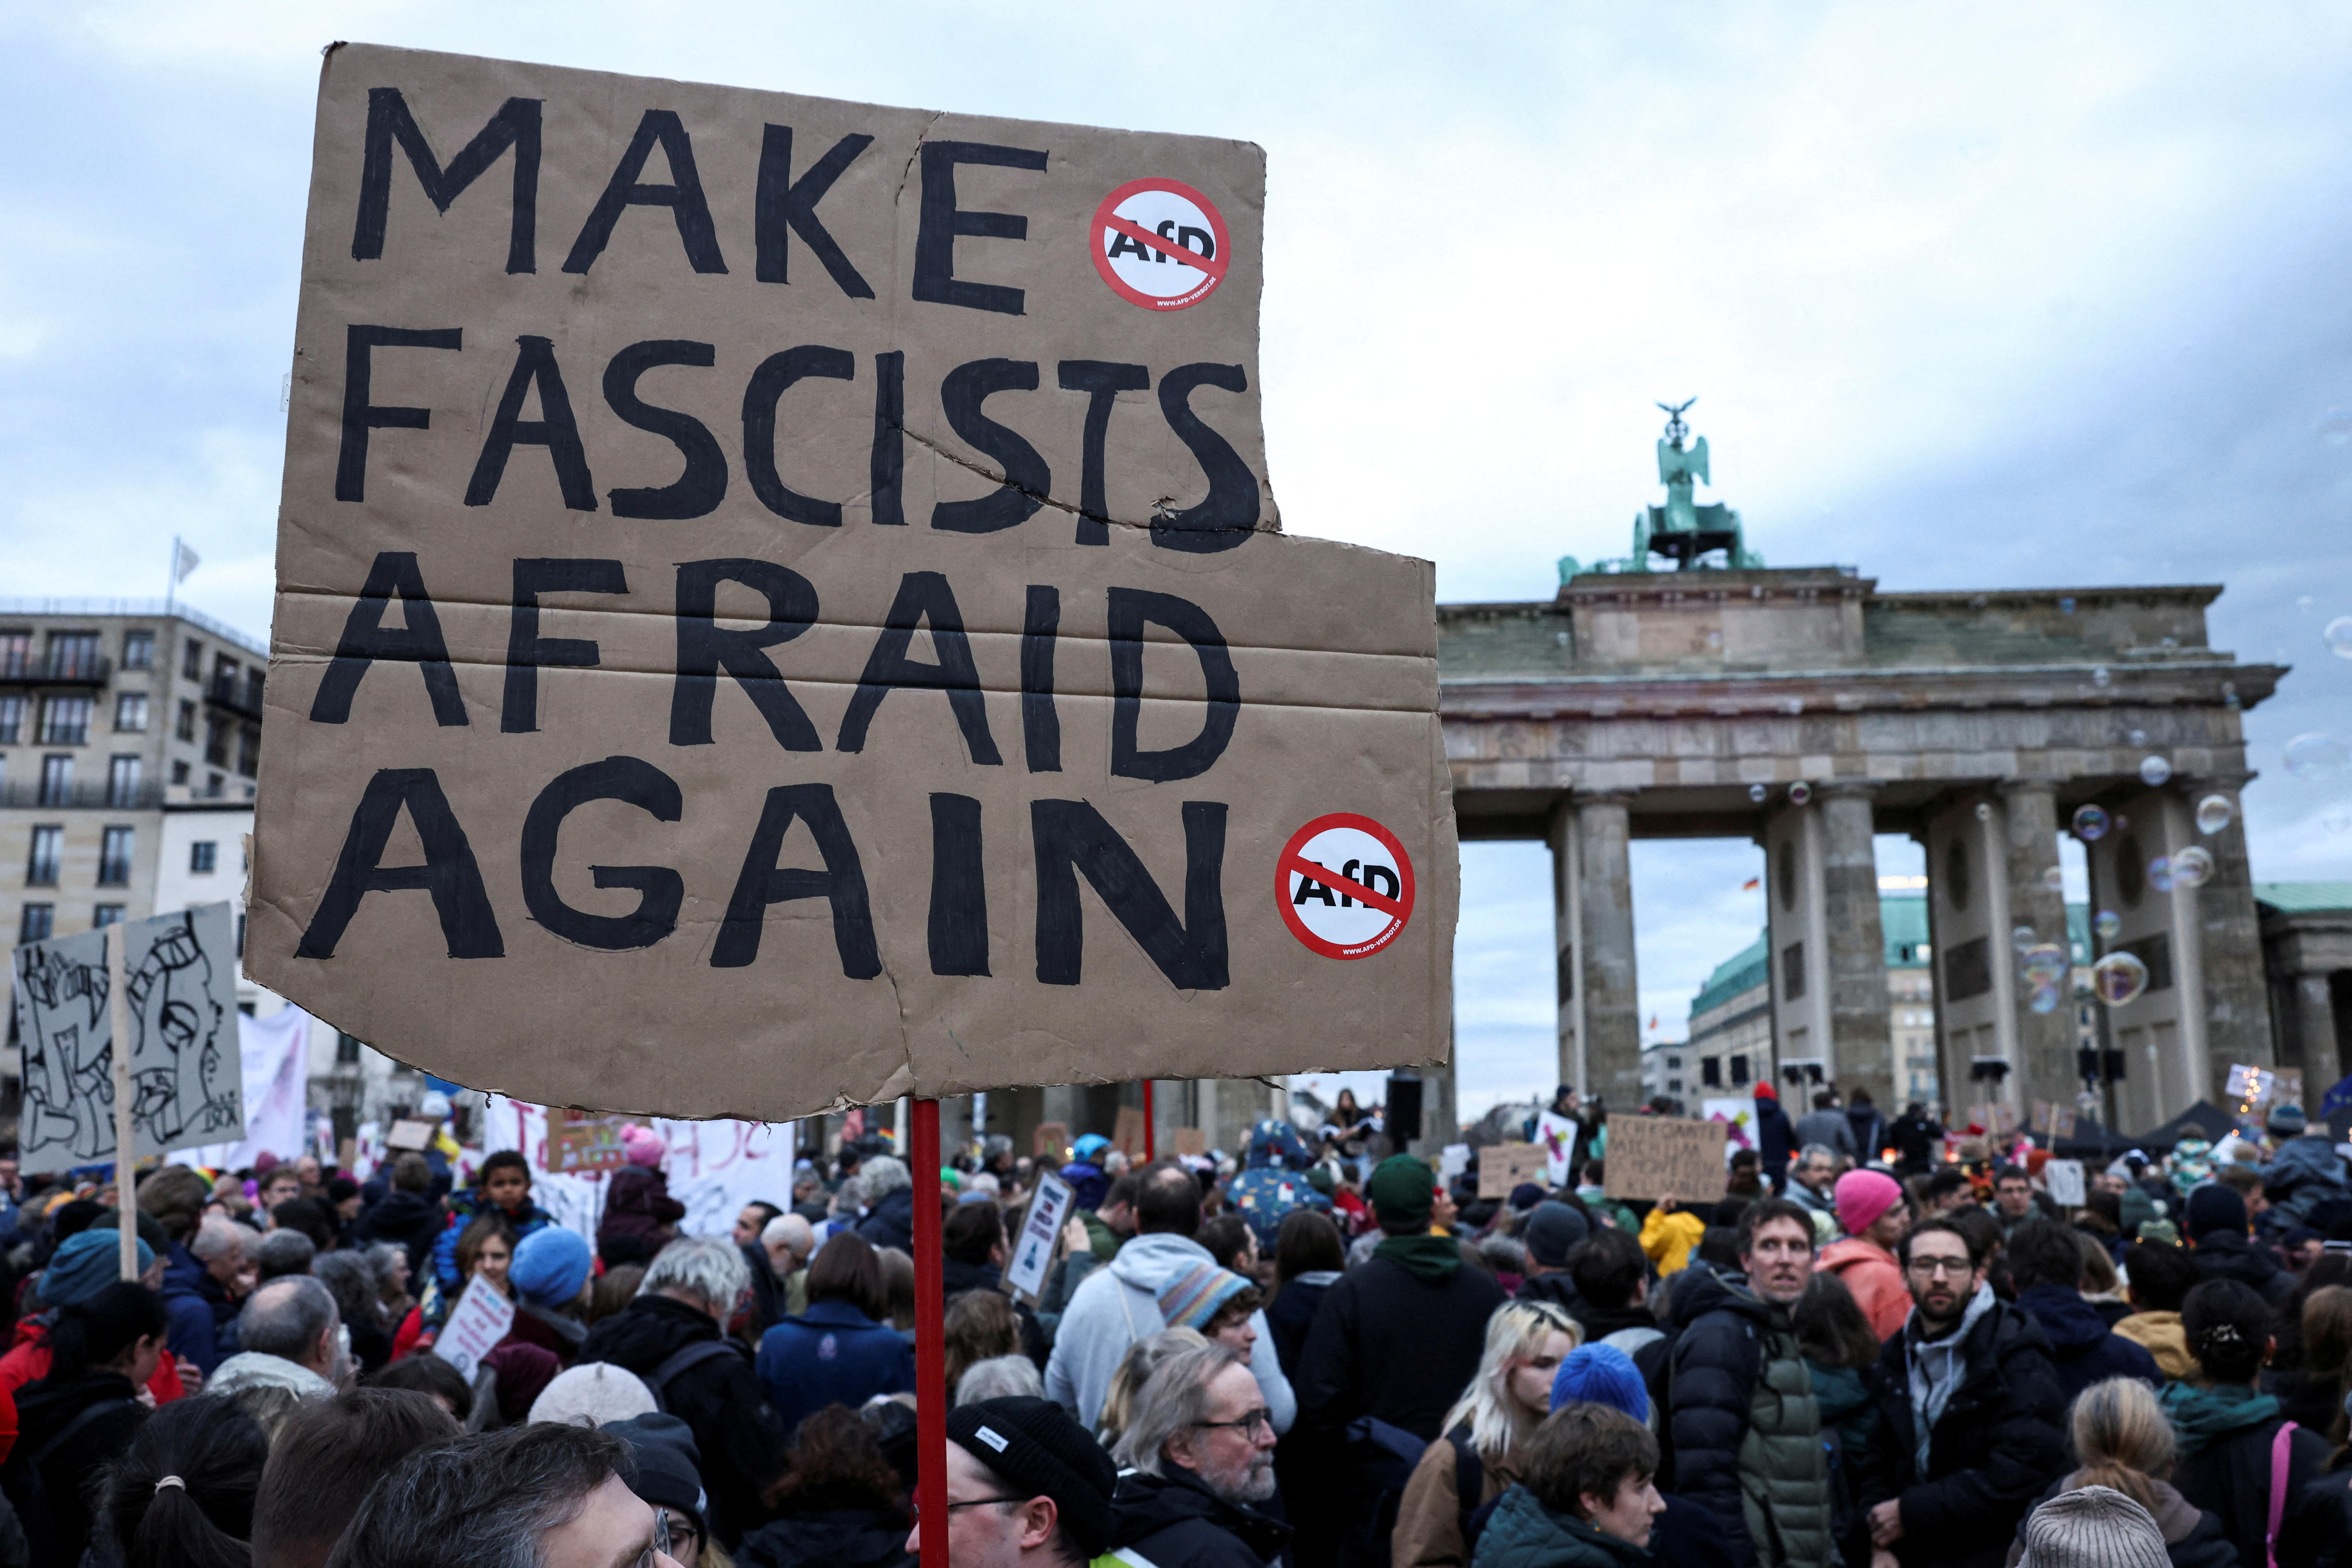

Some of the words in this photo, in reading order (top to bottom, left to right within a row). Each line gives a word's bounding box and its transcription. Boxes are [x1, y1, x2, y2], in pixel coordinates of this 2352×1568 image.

[351, 87, 1049, 316] MAKE
[1107, 219, 1215, 266] AfD
[1157, 276, 1217, 307] WWW.AFD-VERBOT.DE
[334, 324, 1261, 554] FASCISTS
[309, 551, 1242, 784] AFRAID
[295, 755, 1231, 991] AGAIN
[1292, 858, 1400, 909] AfD
[1343, 919, 1402, 955] WWW.AFD-VERBOT.DE
